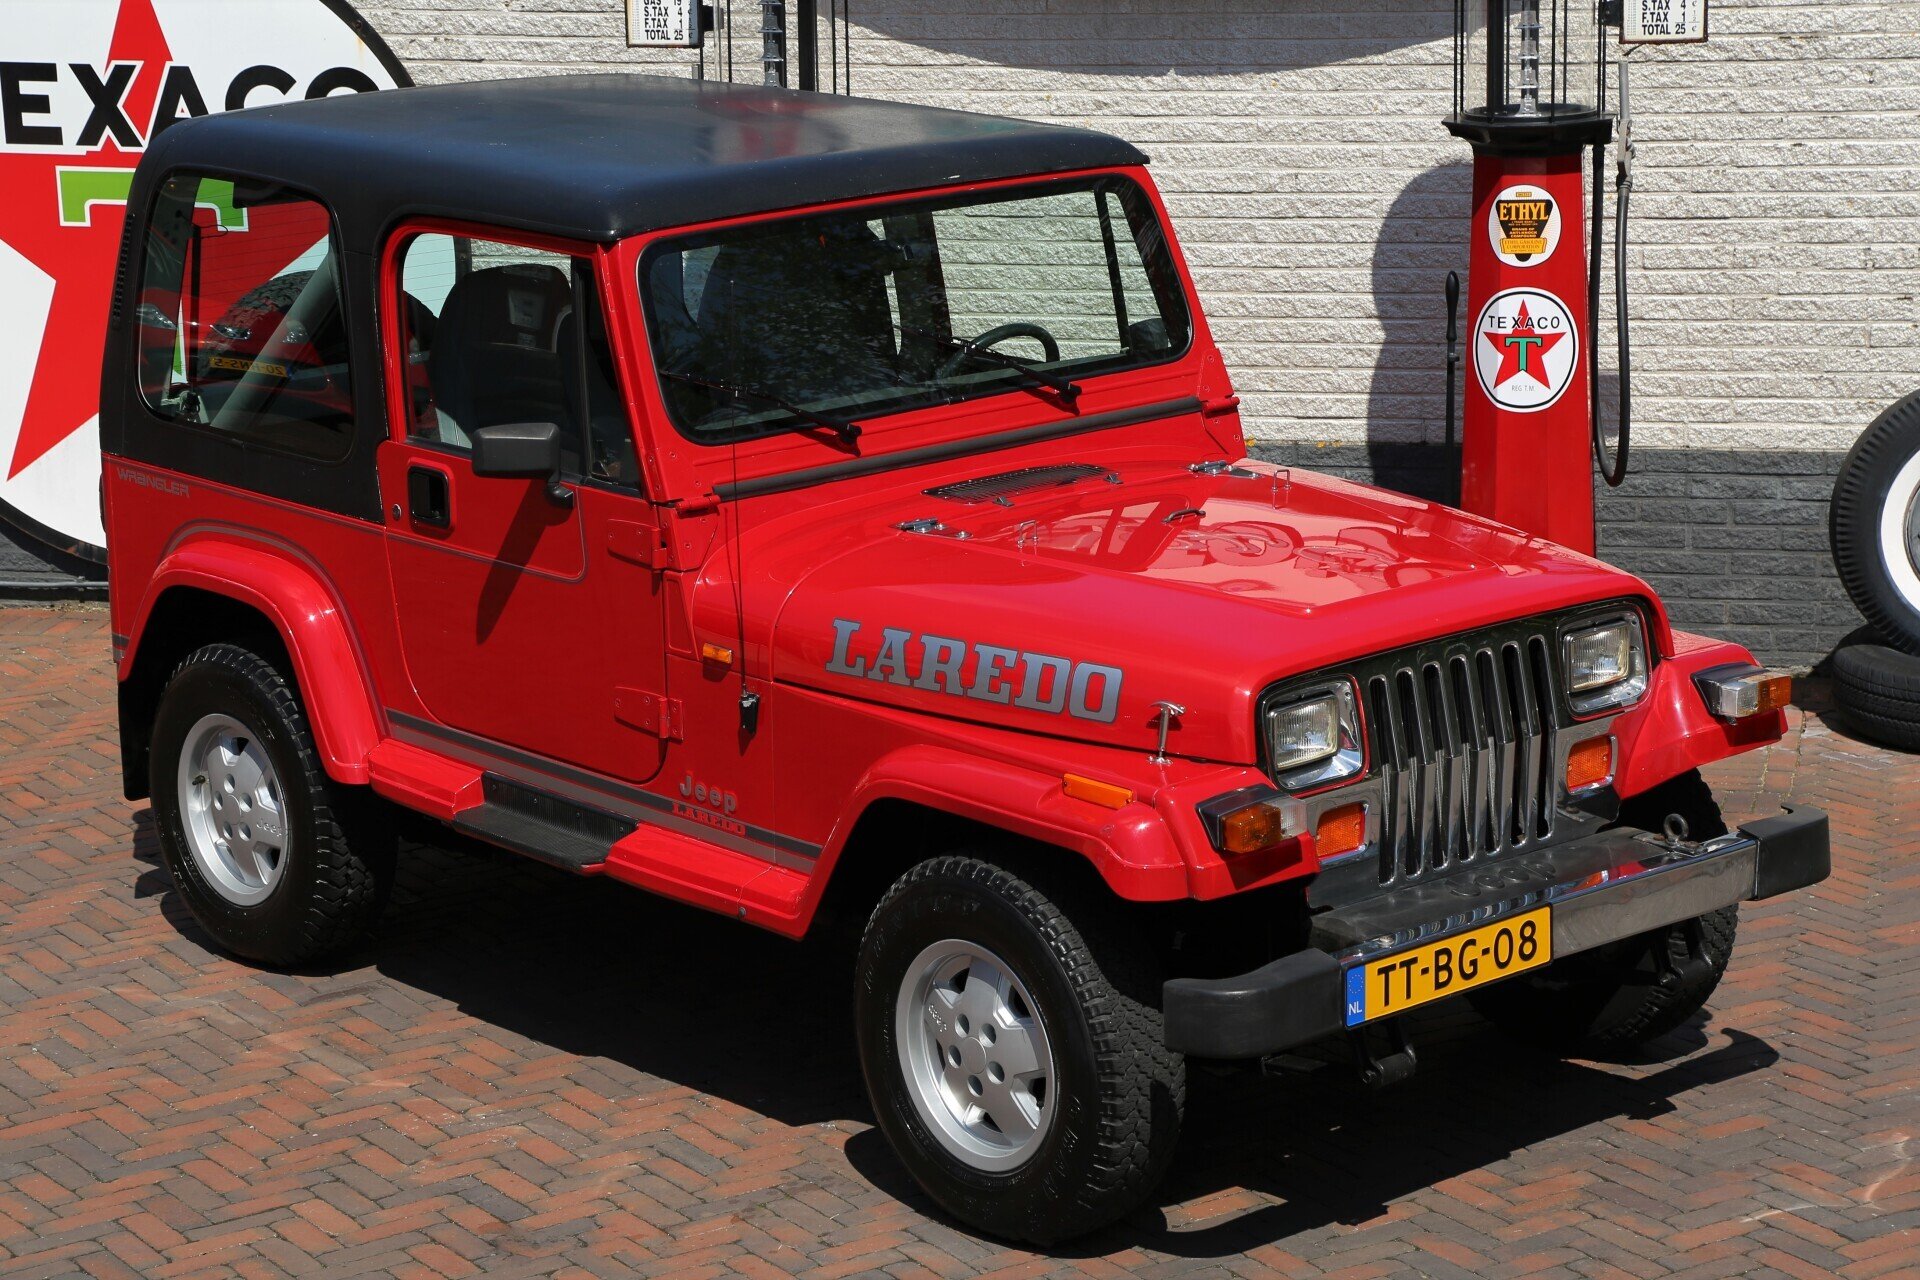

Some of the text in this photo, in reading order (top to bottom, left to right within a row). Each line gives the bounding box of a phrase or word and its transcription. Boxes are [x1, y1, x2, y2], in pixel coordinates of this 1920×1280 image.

[644, 6, 669, 17] S.TAX
[1642, 0, 1670, 11] S.TAX
[644, 18, 668, 29] F.TAX
[1642, 12, 1669, 23] F.TAX
[645, 29, 684, 40] TOTAL 25
[1642, 24, 1671, 36] TOTAL
[1675, 23, 1686, 35] 25
[1499, 202, 1549, 221] ETHYL
[1488, 315, 1560, 330] TEXACO
[116, 466, 191, 499] WRANGLER
[825, 617, 1124, 724] LAREDO
[679, 774, 737, 815] Jeep
[672, 800, 747, 837] LAREDO
[1376, 919, 1539, 1008] TT-BG-08
[1348, 1000, 1363, 1016] NL
